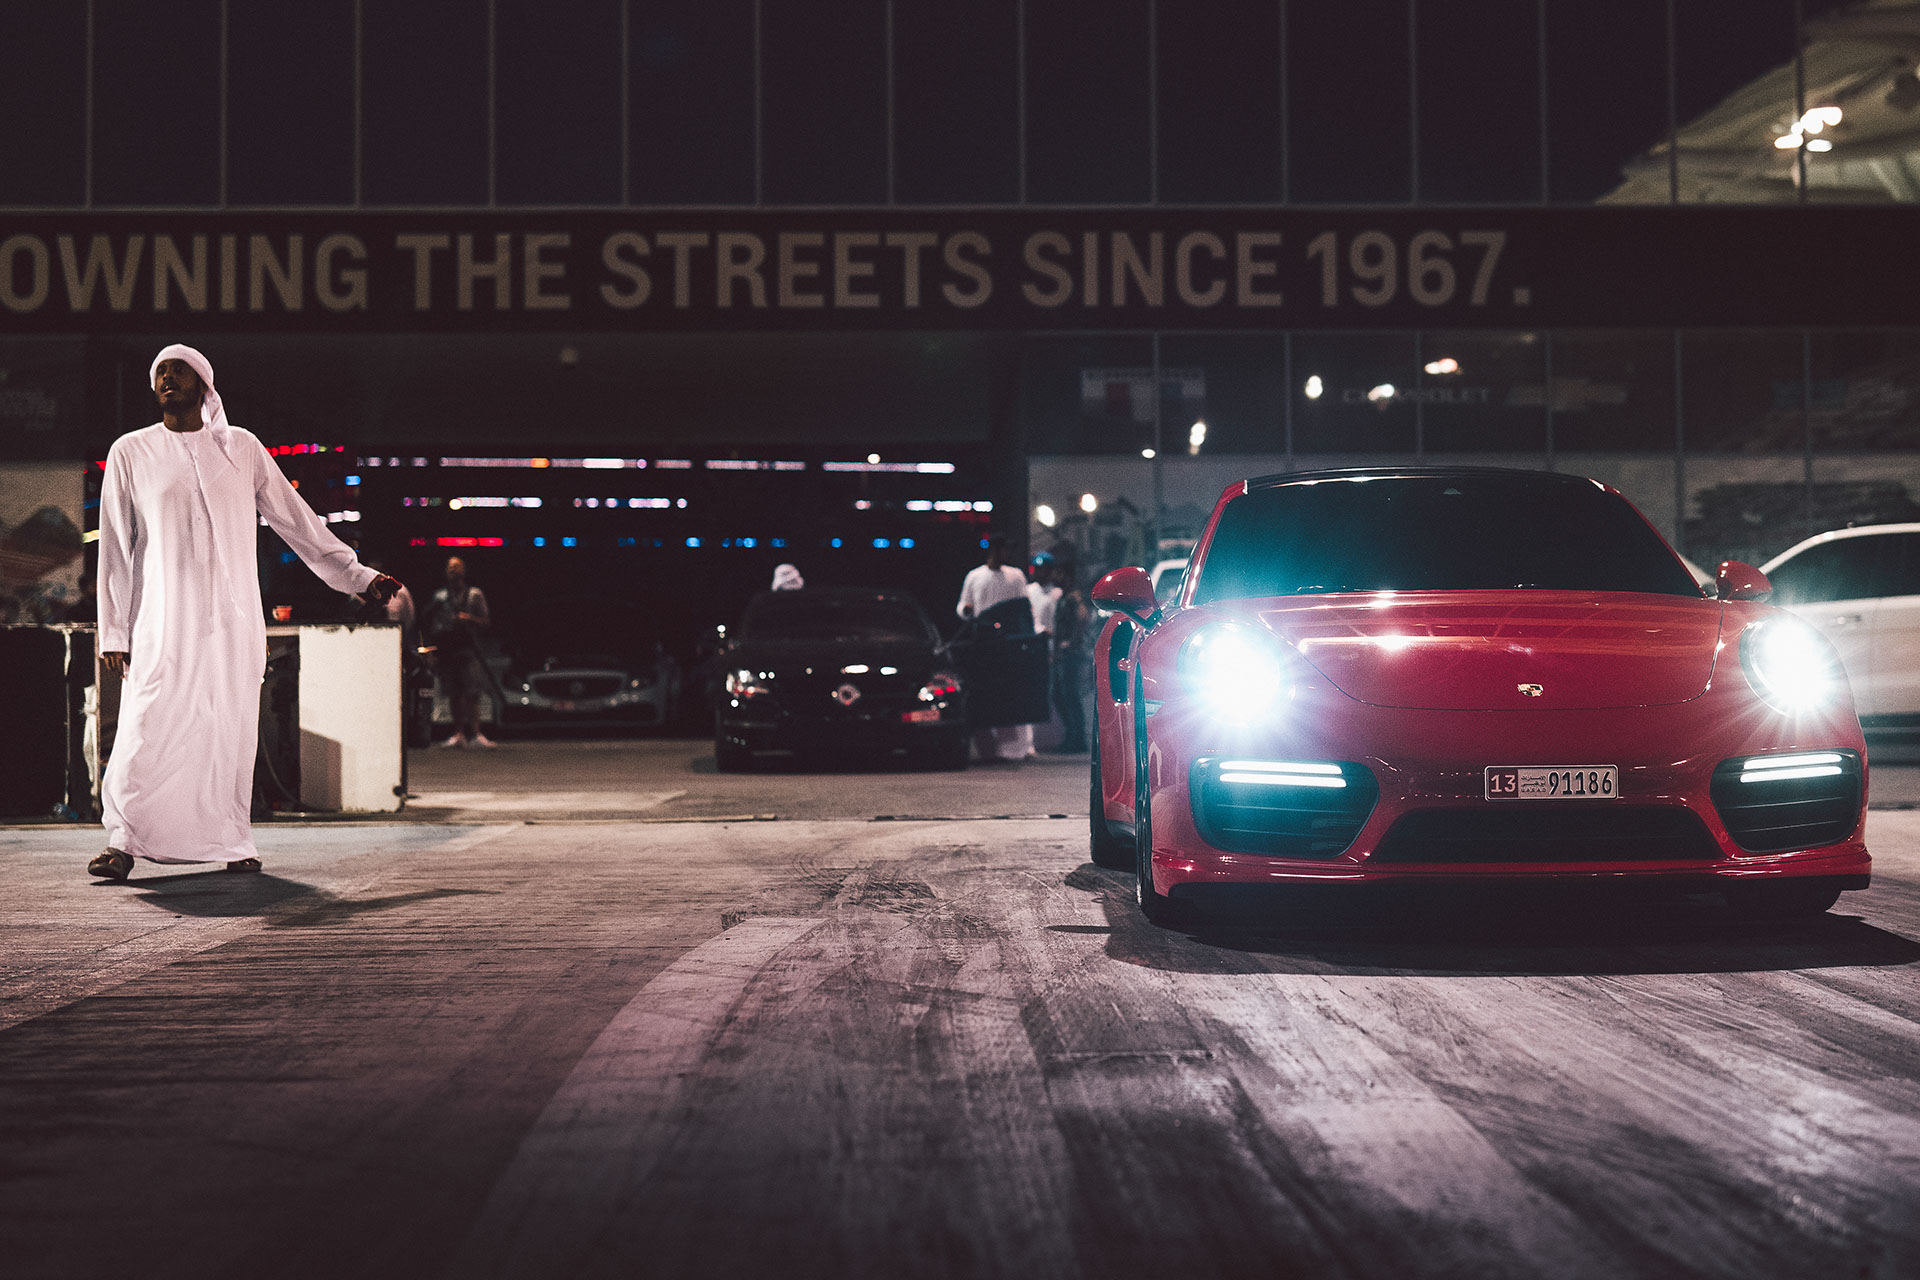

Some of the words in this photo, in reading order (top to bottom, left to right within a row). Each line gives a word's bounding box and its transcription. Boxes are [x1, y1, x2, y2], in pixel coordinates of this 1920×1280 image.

[0, 233, 368, 312] OWNING
[396, 233, 571, 310] THE
[600, 231, 993, 309] STREETS
[1021, 230, 1284, 308] SINCE
[1307, 230, 1531, 307] 1967.
[1490, 774, 1517, 793] 13
[1548, 771, 1613, 795] 91186
